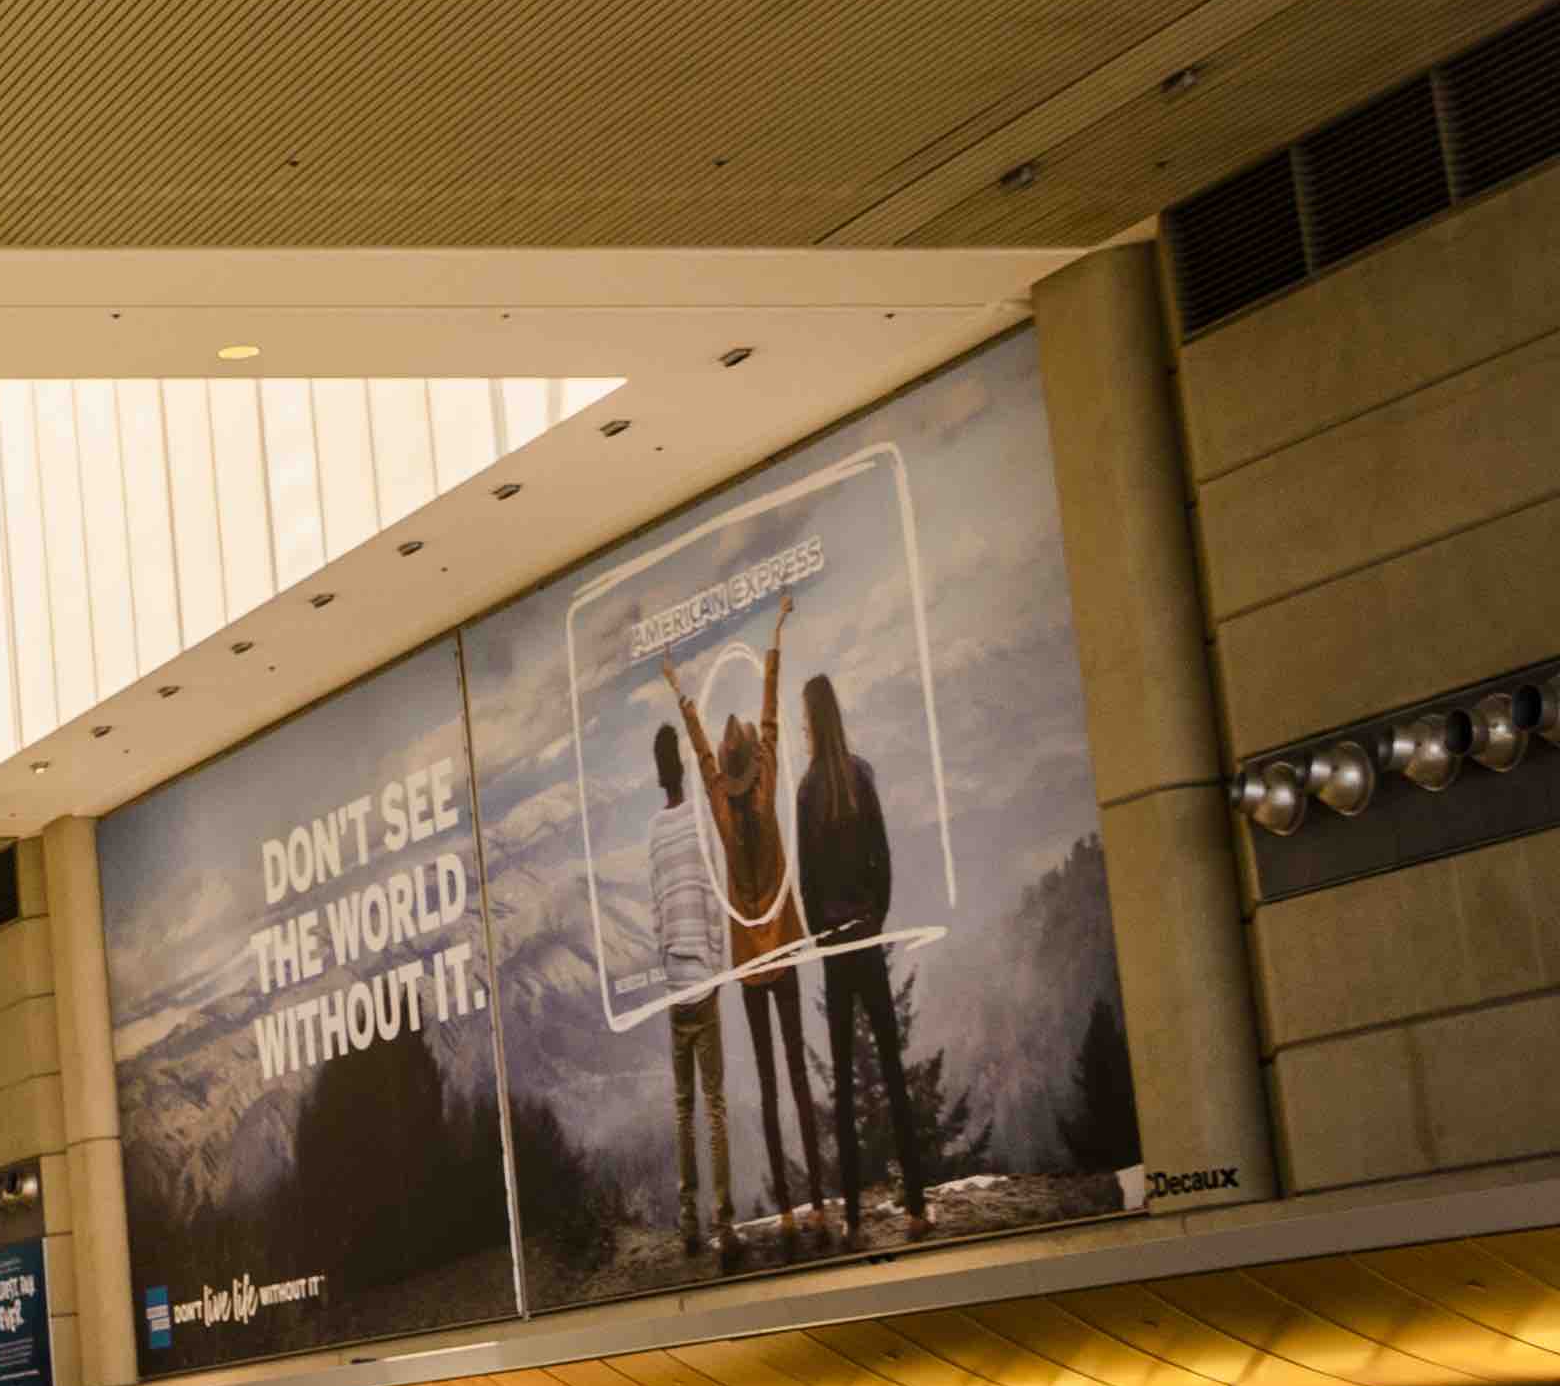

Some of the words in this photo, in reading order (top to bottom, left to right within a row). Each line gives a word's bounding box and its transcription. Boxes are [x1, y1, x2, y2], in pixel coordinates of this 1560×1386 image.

[632, 582, 727, 658] AMERICAN
[731, 534, 824, 615] EXPRESS
[262, 799, 371, 904] DON'T
[383, 757, 458, 852] SEE
[250, 919, 321, 994] THE
[332, 853, 468, 971] WORLD
[255, 960, 422, 1080] WITHOUT
[433, 945, 486, 1027] IT.
